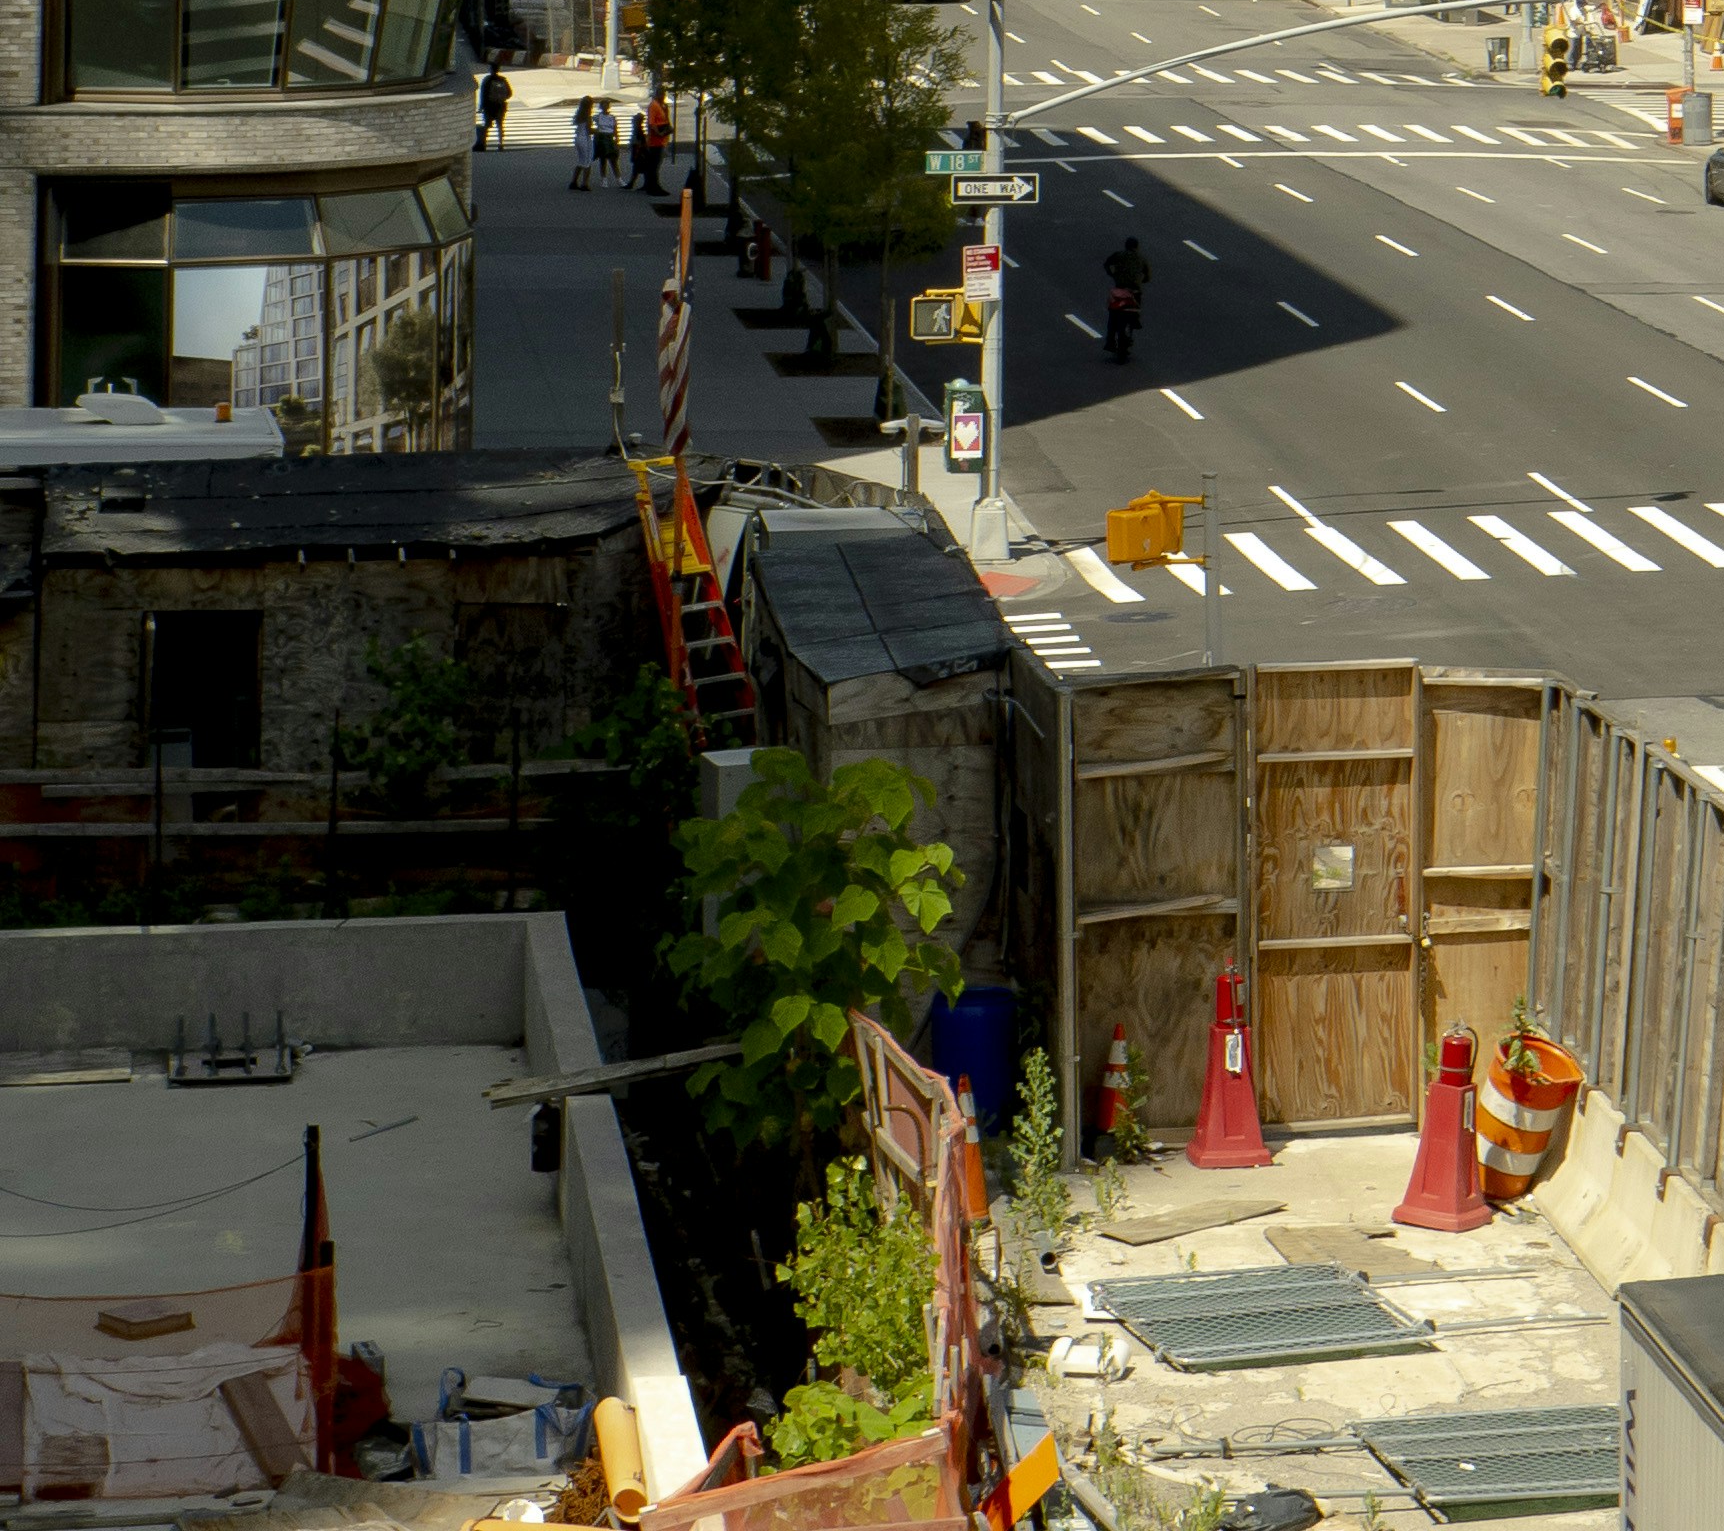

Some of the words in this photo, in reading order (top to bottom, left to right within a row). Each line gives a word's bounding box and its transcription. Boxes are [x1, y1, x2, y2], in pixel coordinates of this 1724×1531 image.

[930, 154, 942, 170] W
[950, 154, 965, 171] 18
[968, 154, 981, 164] ST
[964, 183, 989, 195] ONE
[1000, 183, 1024, 194] WAY
